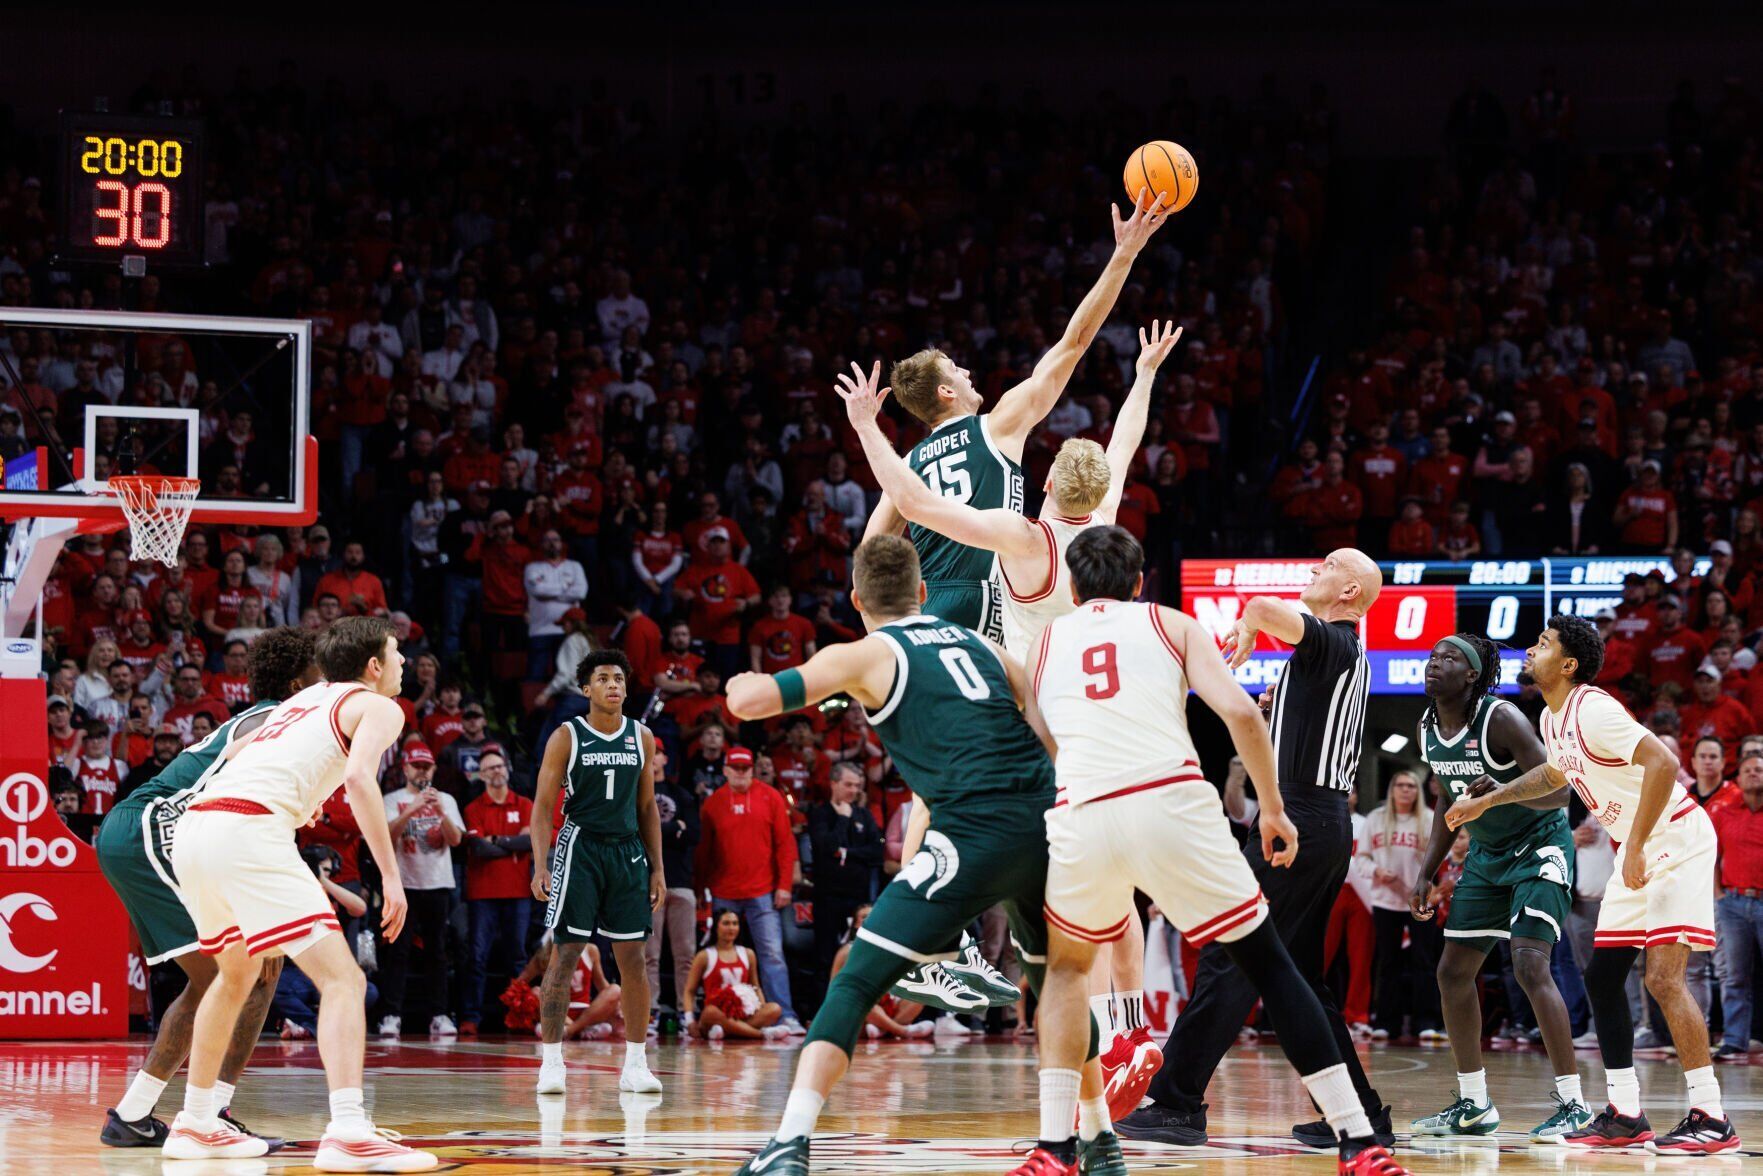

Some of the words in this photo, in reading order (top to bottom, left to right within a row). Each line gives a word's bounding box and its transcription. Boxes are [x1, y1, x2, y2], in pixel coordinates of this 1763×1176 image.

[696, 72, 776, 107] 113
[81, 136, 182, 178] 20:00
[94, 180, 170, 248] 30
[919, 428, 971, 462] COOPER
[922, 450, 973, 504] 15
[1393, 563, 1426, 584] 1ST
[1469, 561, 1532, 584] 20:00
[1092, 604, 1105, 613] N
[1394, 596, 1428, 640] 0
[1487, 596, 1520, 640] 0
[938, 646, 991, 701] 0
[1082, 642, 1120, 700] 9
[581, 752, 638, 766] SPARTANS
[1429, 761, 1485, 776] SPARTANS
[603, 769, 615, 800] 1
[95, 792, 103, 815] 1
[793, 902, 815, 924] N
[720, 967, 744, 990] N
[1162, 1116, 1191, 1127] HOKA
